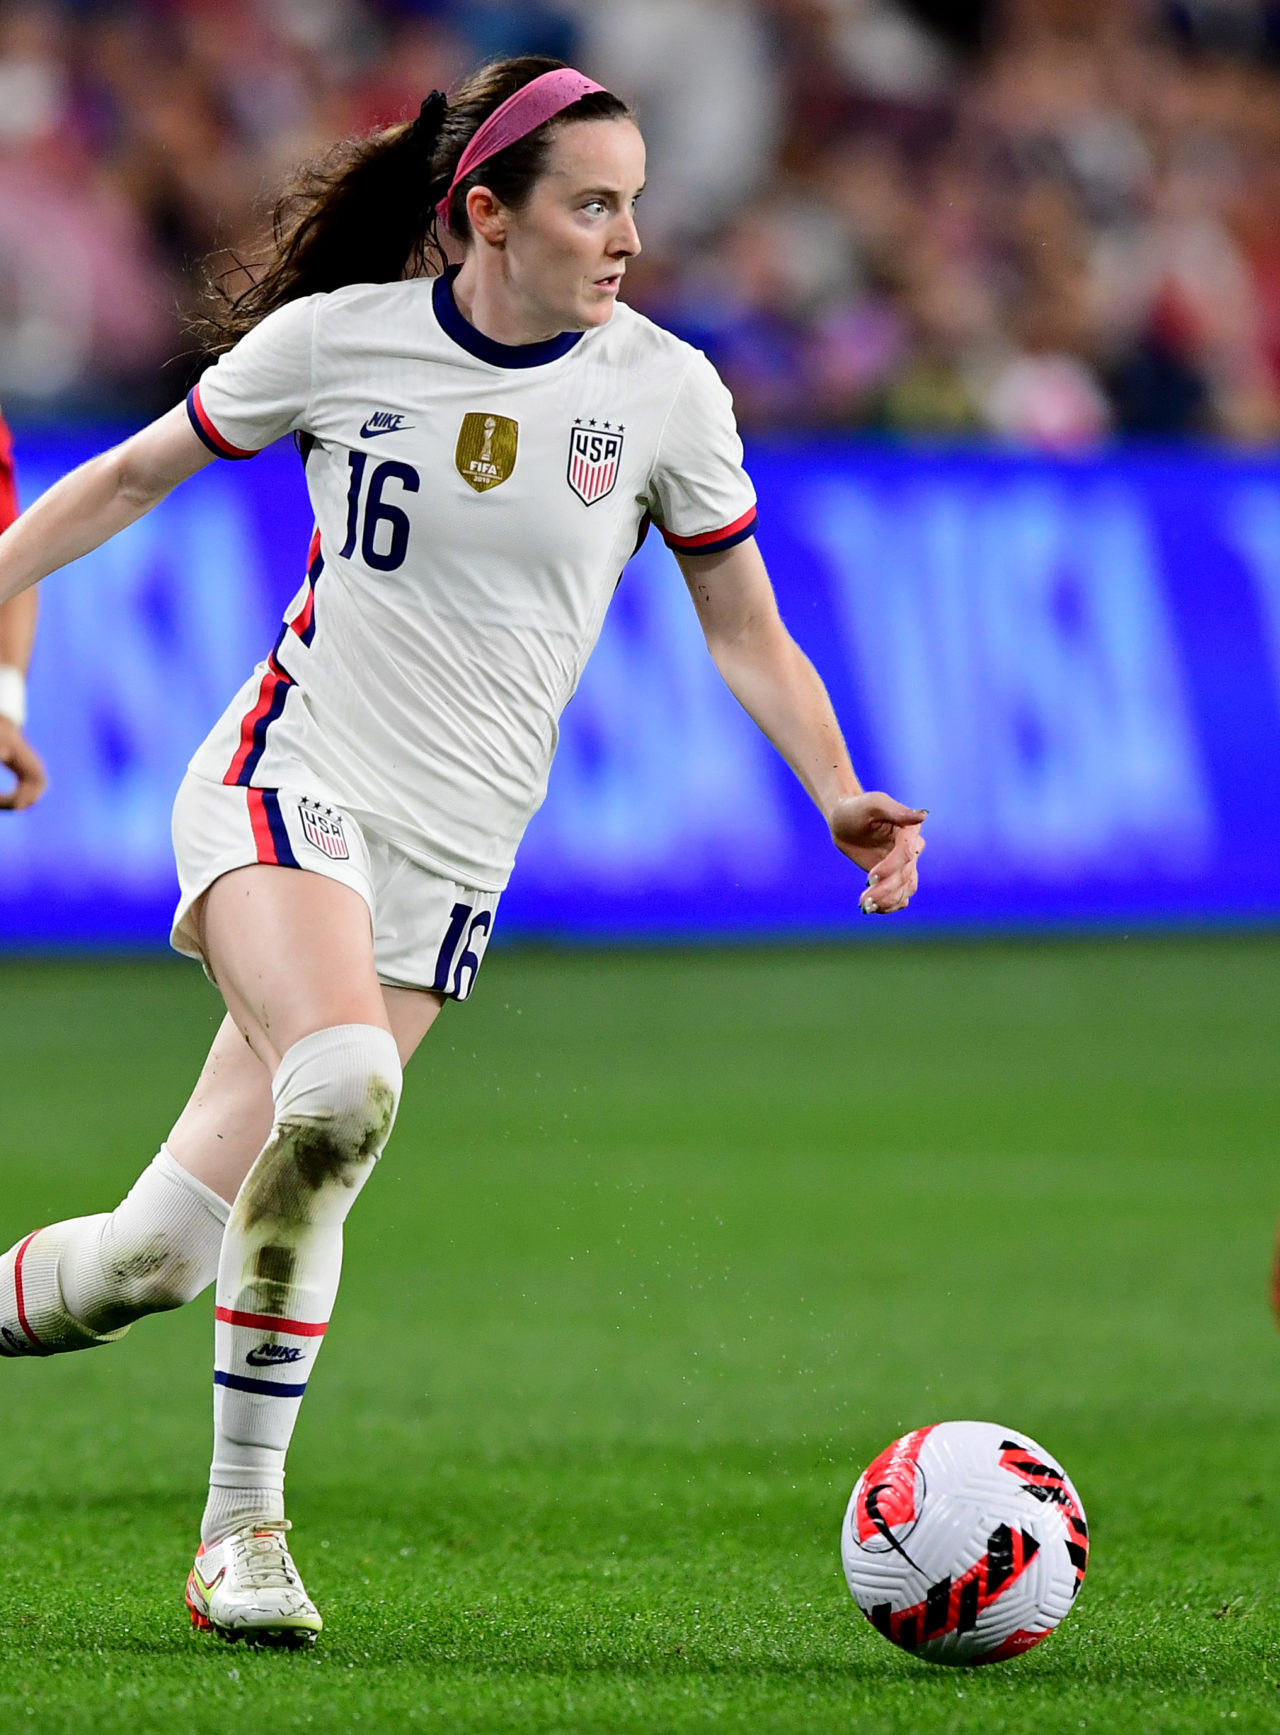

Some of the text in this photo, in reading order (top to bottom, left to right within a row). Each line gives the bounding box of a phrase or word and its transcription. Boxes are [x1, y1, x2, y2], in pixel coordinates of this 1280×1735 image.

[577, 434, 617, 462] USA
[469, 460, 497, 475] FIFA
[338, 450, 420, 571] 16
[305, 810, 341, 837] USA
[432, 902, 491, 1001] 16
[257, 1343, 302, 1361] NIKE
